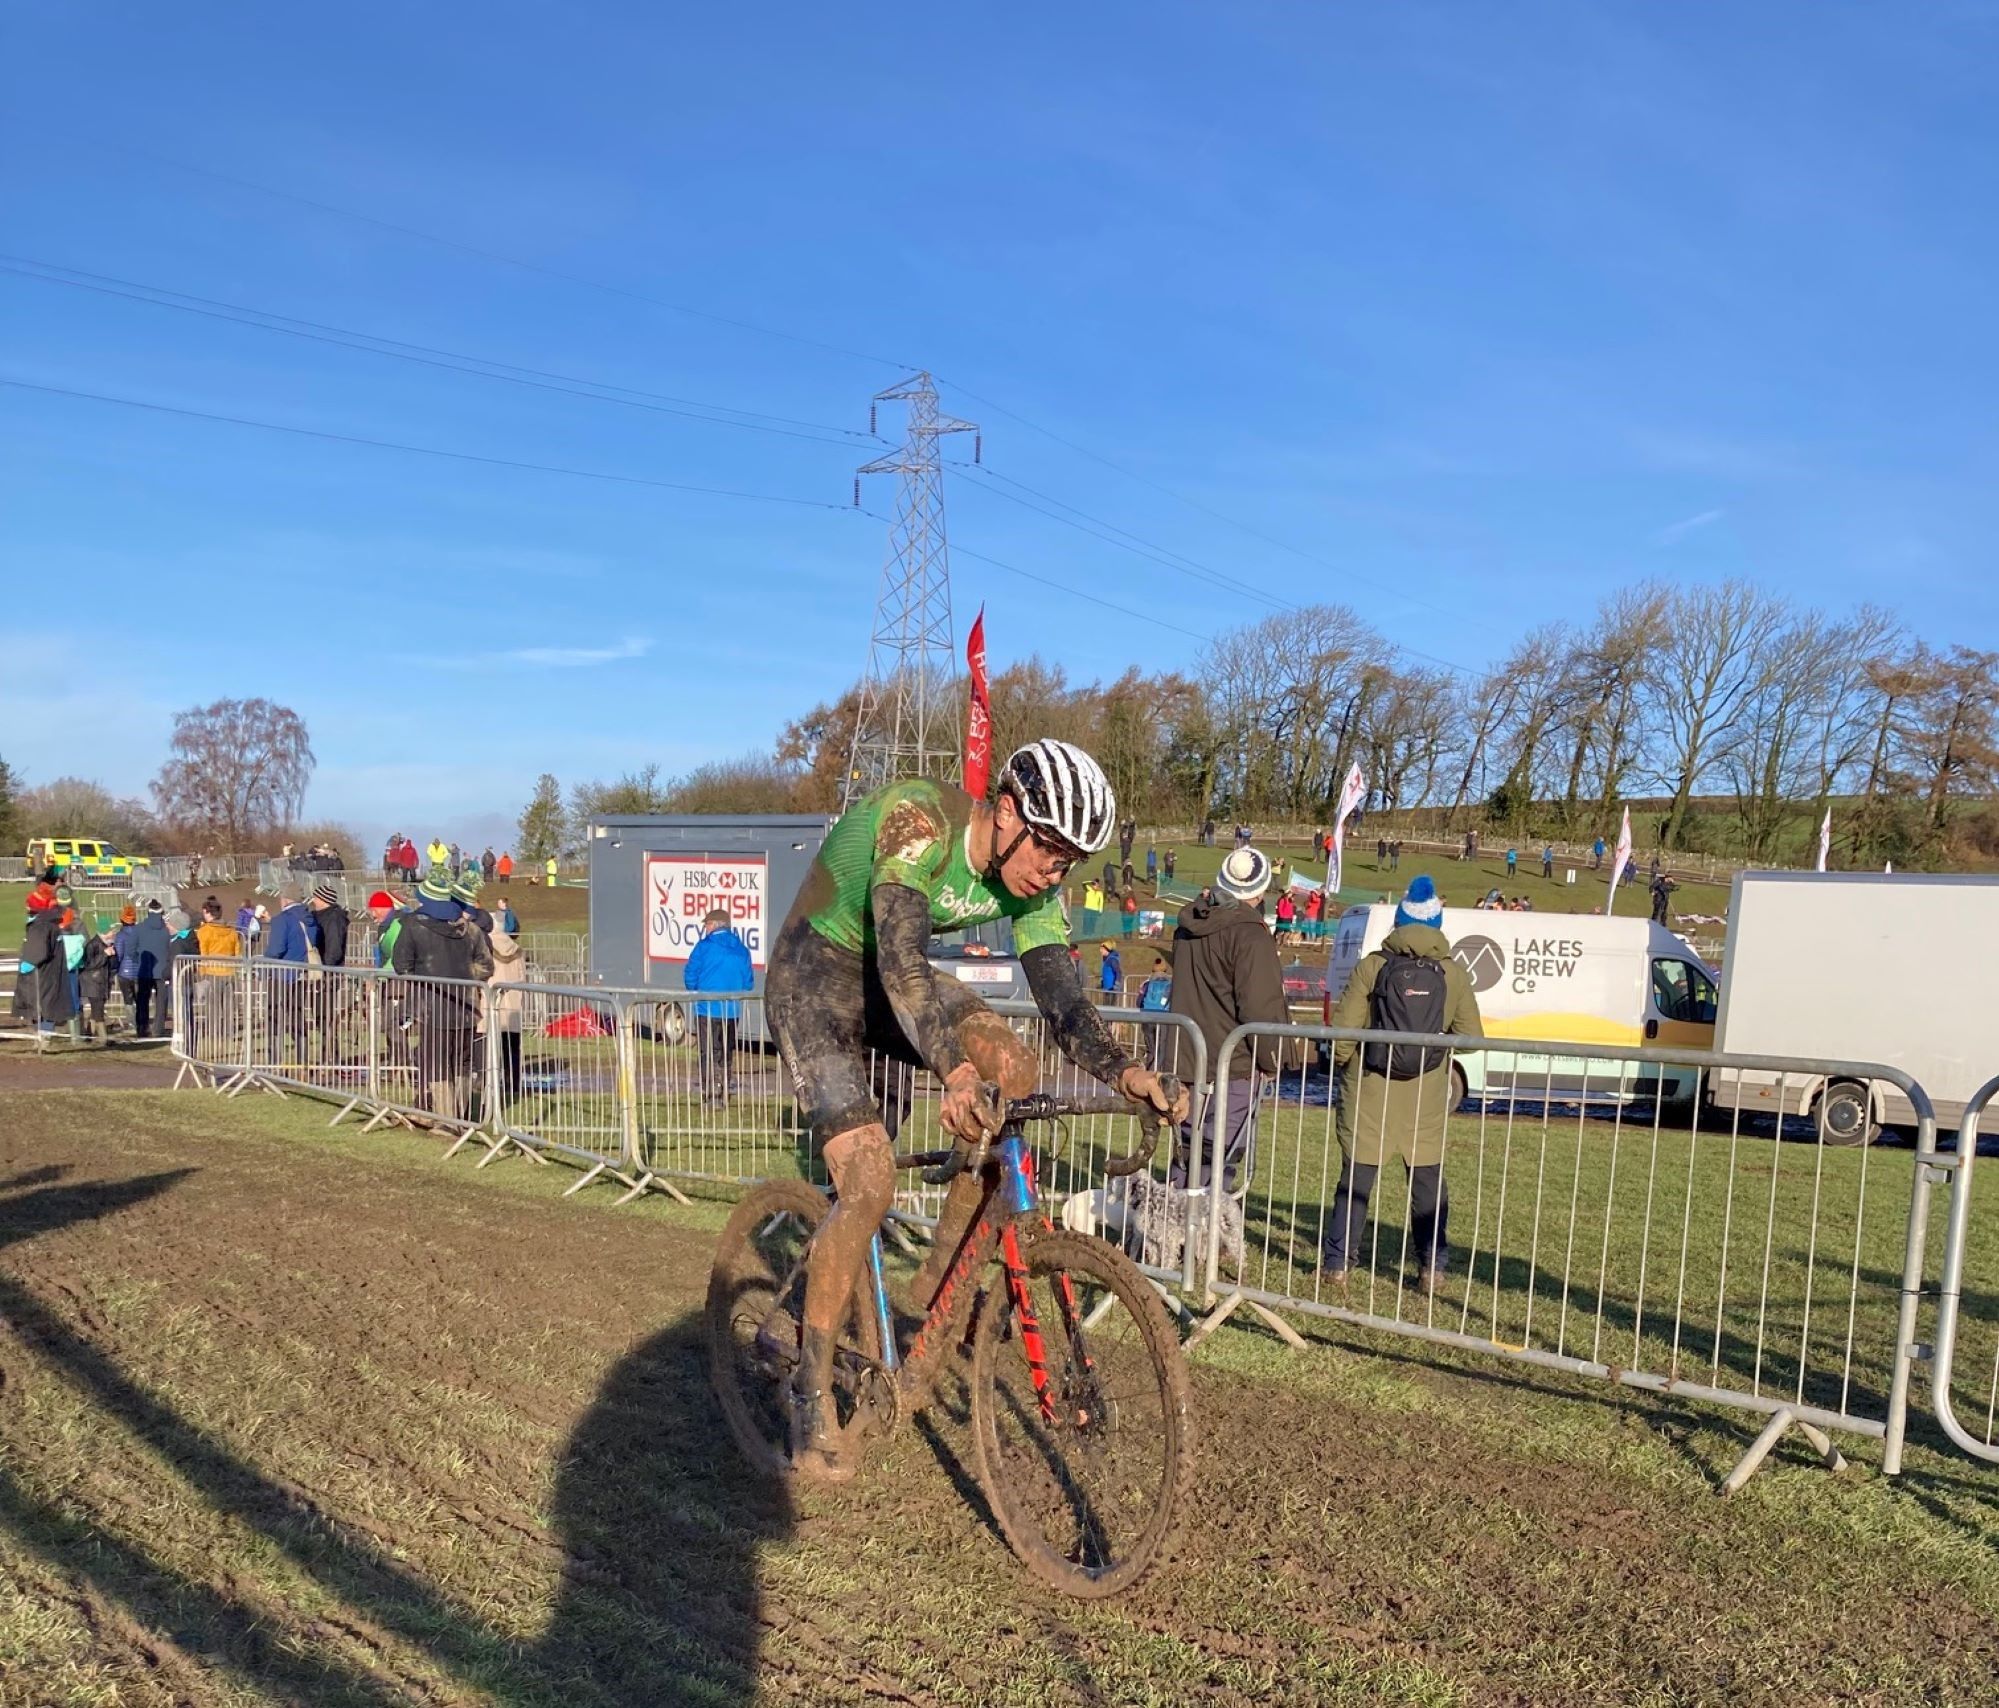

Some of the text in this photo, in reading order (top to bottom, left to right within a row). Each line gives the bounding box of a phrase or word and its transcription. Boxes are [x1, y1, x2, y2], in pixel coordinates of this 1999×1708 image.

[684, 870, 759, 890] HSBC UK
[683, 893, 760, 920] BRITISH
[683, 923, 760, 951] CYNG
[1513, 937, 1584, 958] LAKES
[1512, 957, 1576, 977] BREW
